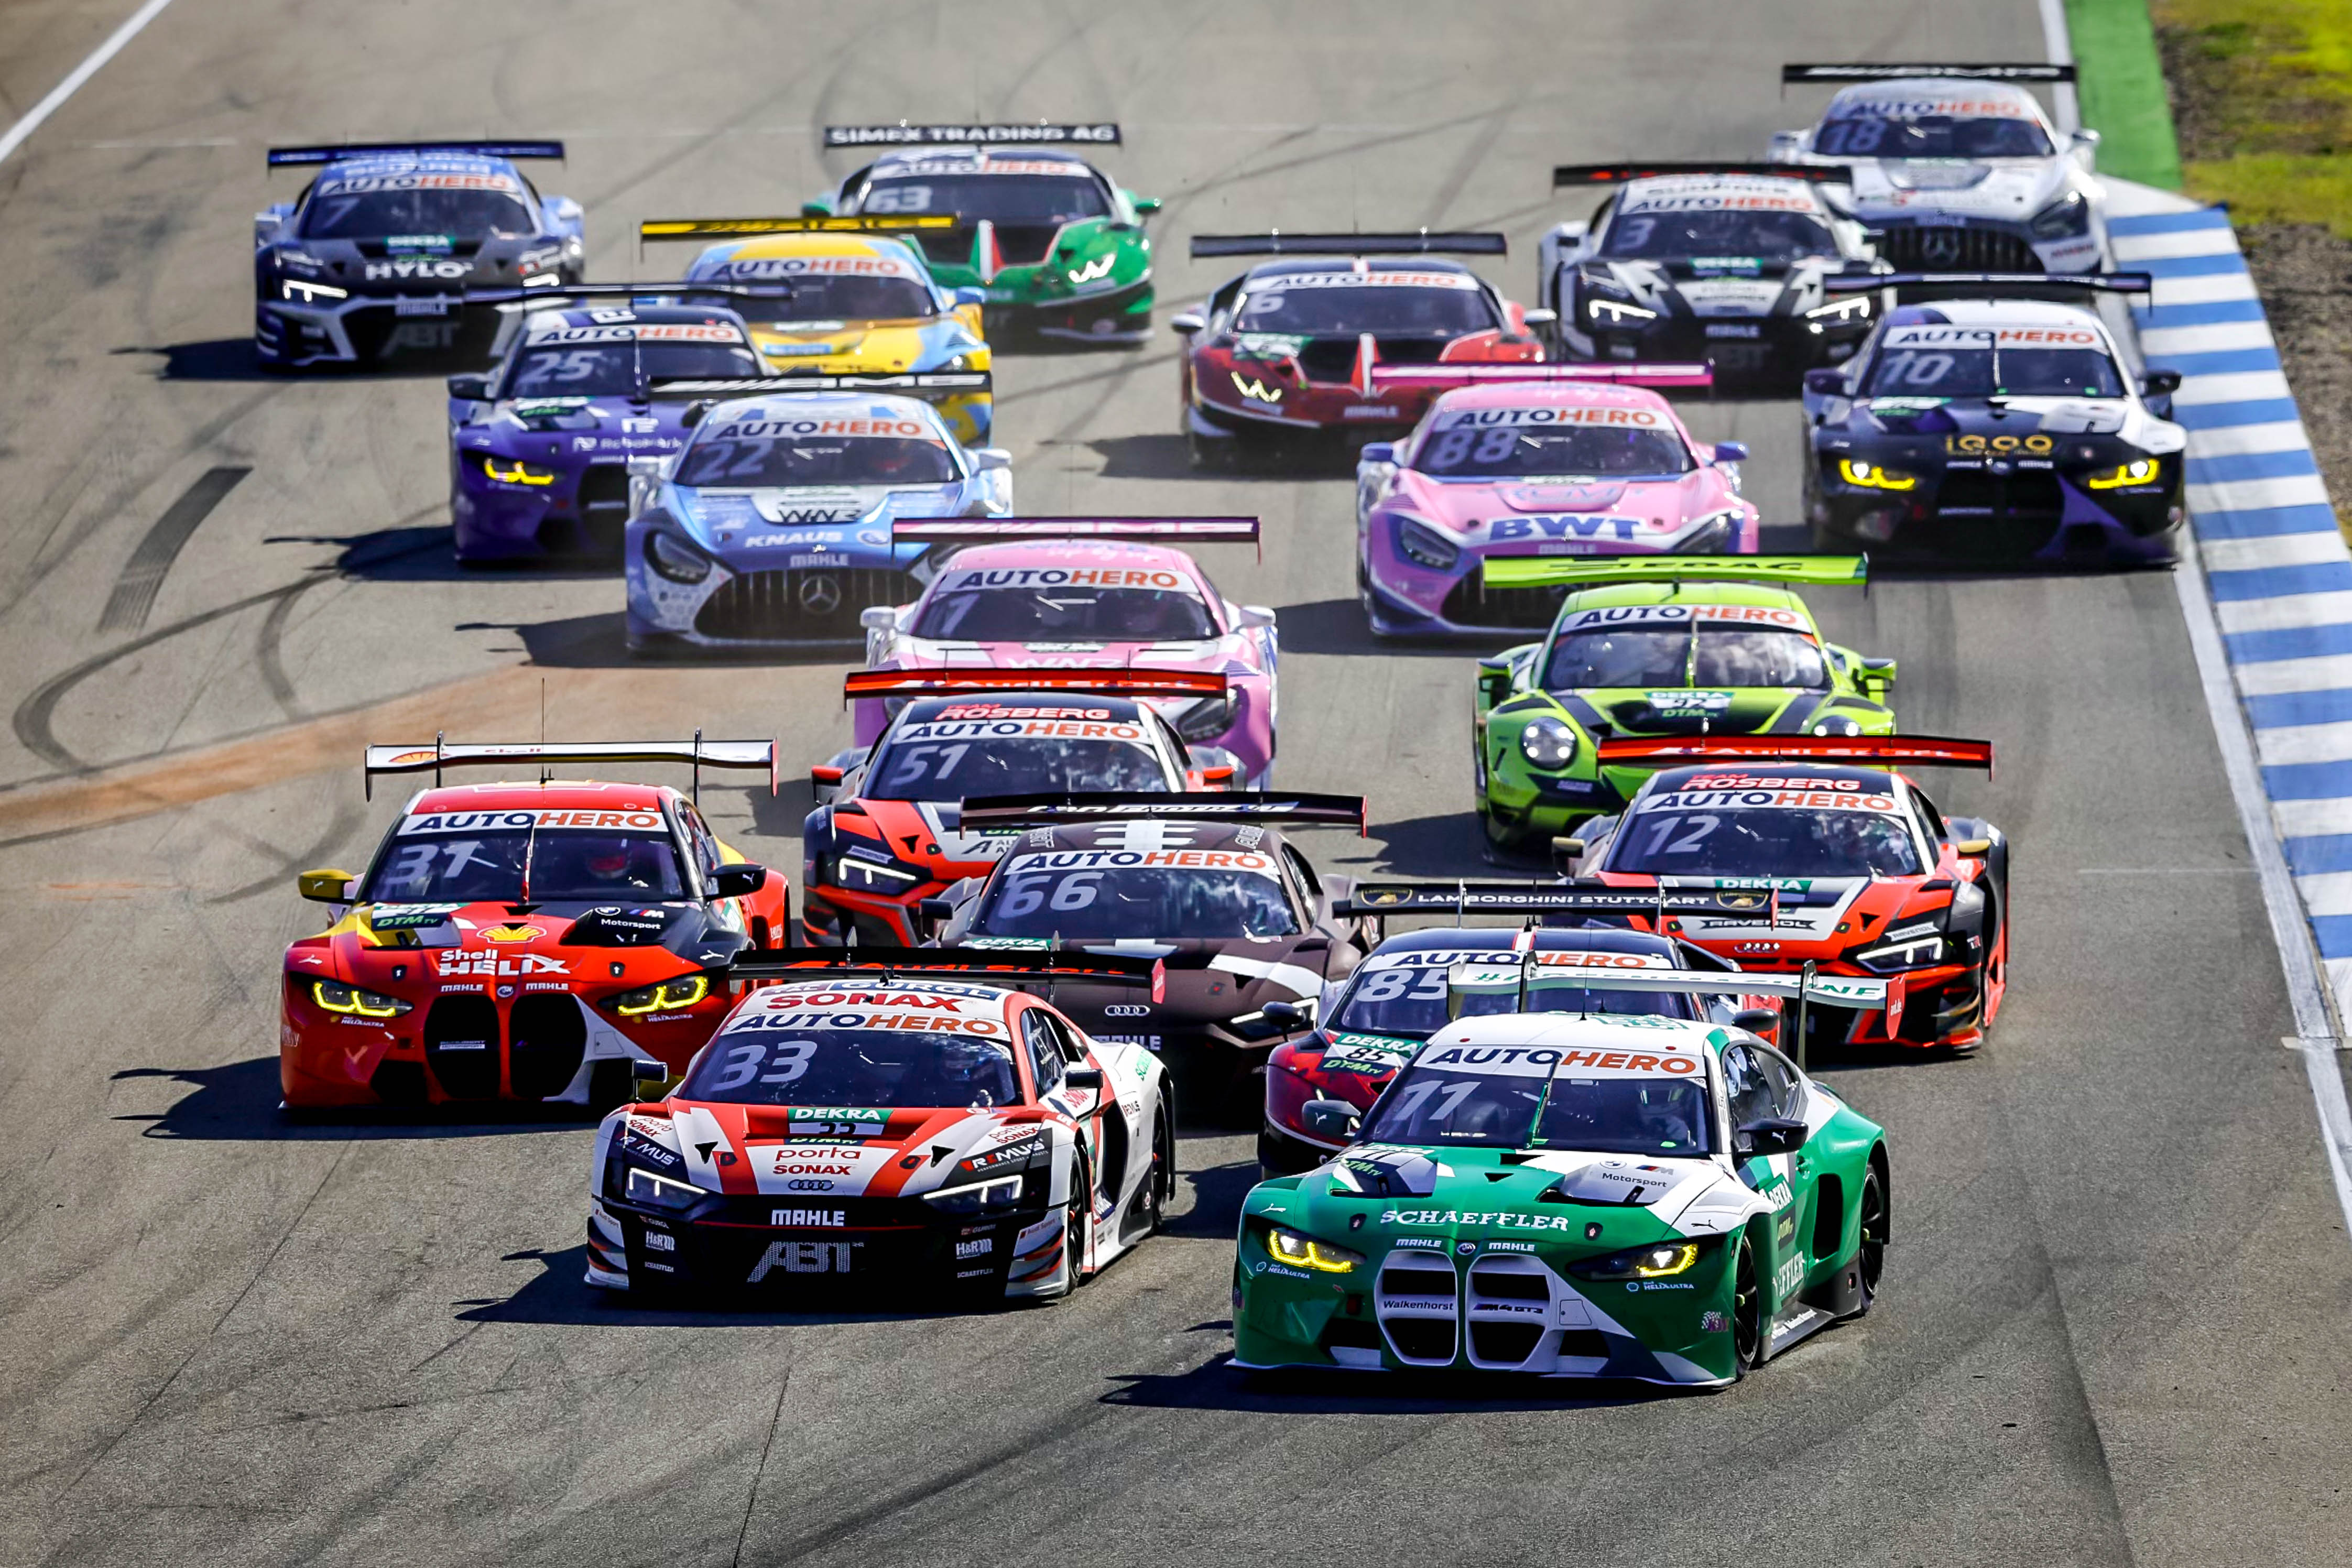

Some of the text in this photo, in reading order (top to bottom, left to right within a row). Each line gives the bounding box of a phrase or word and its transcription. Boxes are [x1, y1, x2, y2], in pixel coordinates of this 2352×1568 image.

[1850, 101, 2022, 116] AUTOHERO
[830, 125, 1114, 143] SIMEX TRADING AG
[321, 173, 507, 195] AUTOHERO
[865, 186, 932, 212] 63
[1631, 197, 1813, 211] AUTOHERO
[1618, 218, 1658, 249] 3
[366, 262, 465, 280] HYLO
[714, 259, 901, 277] AUTOHERO
[1272, 272, 1457, 288] AUTOHERO
[539, 326, 734, 342] AUTOHERO
[1900, 329, 2095, 344] AUTOHERO
[520, 351, 602, 383] 25
[1885, 351, 1955, 385] 10
[1456, 408, 1657, 427] AUTOHERO
[716, 420, 922, 440] AUTOHERO
[1427, 427, 1520, 467] 88
[685, 439, 775, 482] 22
[1489, 516, 1641, 541] BWT
[744, 531, 843, 548] KNAUS
[790, 553, 850, 568] MAHLE
[957, 569, 1179, 589] AUTOHERO
[943, 593, 980, 630] 1
[1574, 605, 1798, 627] AUTOHERO
[934, 707, 1110, 721] ROSBERG
[1662, 709, 1706, 717] DTM
[905, 723, 1140, 739] AUTOHERO
[890, 744, 971, 786] 51
[1680, 778, 1861, 791] ROSBERG
[1653, 791, 1894, 810] AUTOHERO
[410, 811, 659, 832] AUTOHERO
[1643, 815, 1721, 856] 12
[390, 840, 484, 887] 31
[1015, 851, 1267, 871] AUTOHERO
[1722, 879, 1803, 890] DEKRA
[997, 872, 1105, 920] 66
[1418, 894, 1573, 905] LAMBORGHINI
[1580, 895, 1710, 906] STUTTGART
[376, 916, 424, 927] DTM
[601, 918, 661, 930] Motorsport
[1893, 925, 1933, 940] RAVENOL
[977, 938, 1048, 947] DEKRA
[439, 953, 571, 976] HELIX
[440, 949, 498, 962] Shell
[1395, 952, 1648, 968] AUTOHERO
[441, 984, 484, 993] MAHLE
[525, 982, 569, 990] MAHLE
[841, 981, 995, 999] GURGL
[1356, 969, 1448, 1003] 85
[767, 994, 965, 1013] SONAX
[731, 1012, 999, 1036] AUTOHERO
[1340, 1035, 1419, 1053] DEKRA
[1345, 1048, 1390, 1062] 85
[1427, 1048, 1697, 1074] AUTOHERO
[709, 1040, 818, 1092] 33
[1393, 1080, 1482, 1121] 11
[794, 1108, 881, 1120] DEKRA
[996, 1127, 1040, 1144] SONAX
[775, 1147, 861, 1162] porta
[972, 1140, 1045, 1169] REMUS
[772, 1164, 852, 1175] SONAX
[1602, 1171, 1668, 1189] Motorsport
[771, 1209, 845, 1226] MAHLE
[1380, 1210, 1569, 1232] SCHAEFFLER
[1396, 1238, 1442, 1248] MAHLE
[1488, 1241, 1535, 1251] MAHLE
[747, 1241, 852, 1283] ABT
[1383, 1300, 1454, 1311] Walkenhorst
[1513, 1305, 1544, 1314] GT3
